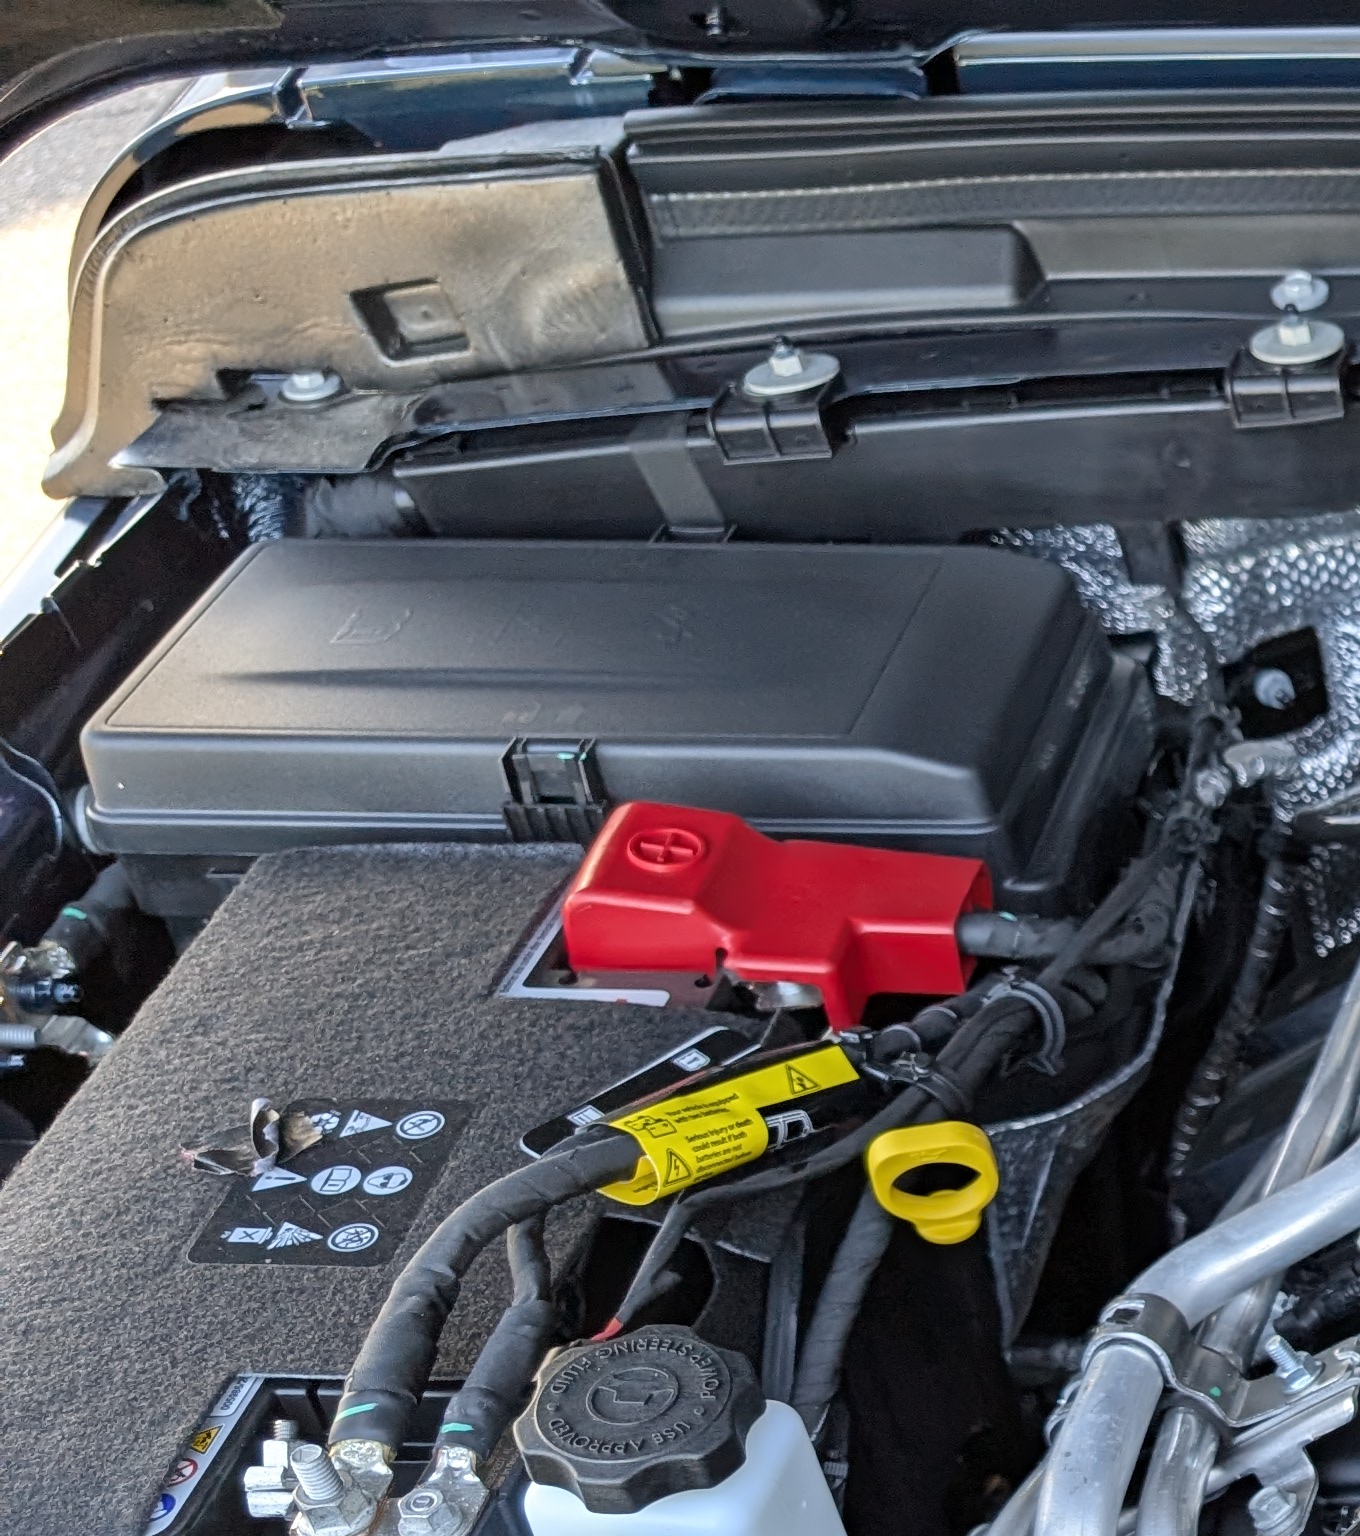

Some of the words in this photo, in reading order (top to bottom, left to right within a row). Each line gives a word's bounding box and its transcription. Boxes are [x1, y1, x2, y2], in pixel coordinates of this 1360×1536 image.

[595, 1336, 693, 1360] STEERING
[550, 1357, 592, 1395] FLUID
[689, 1353, 720, 1401] POWER
[548, 1417, 646, 1454] APPROVED
[651, 1420, 692, 1445] USE
